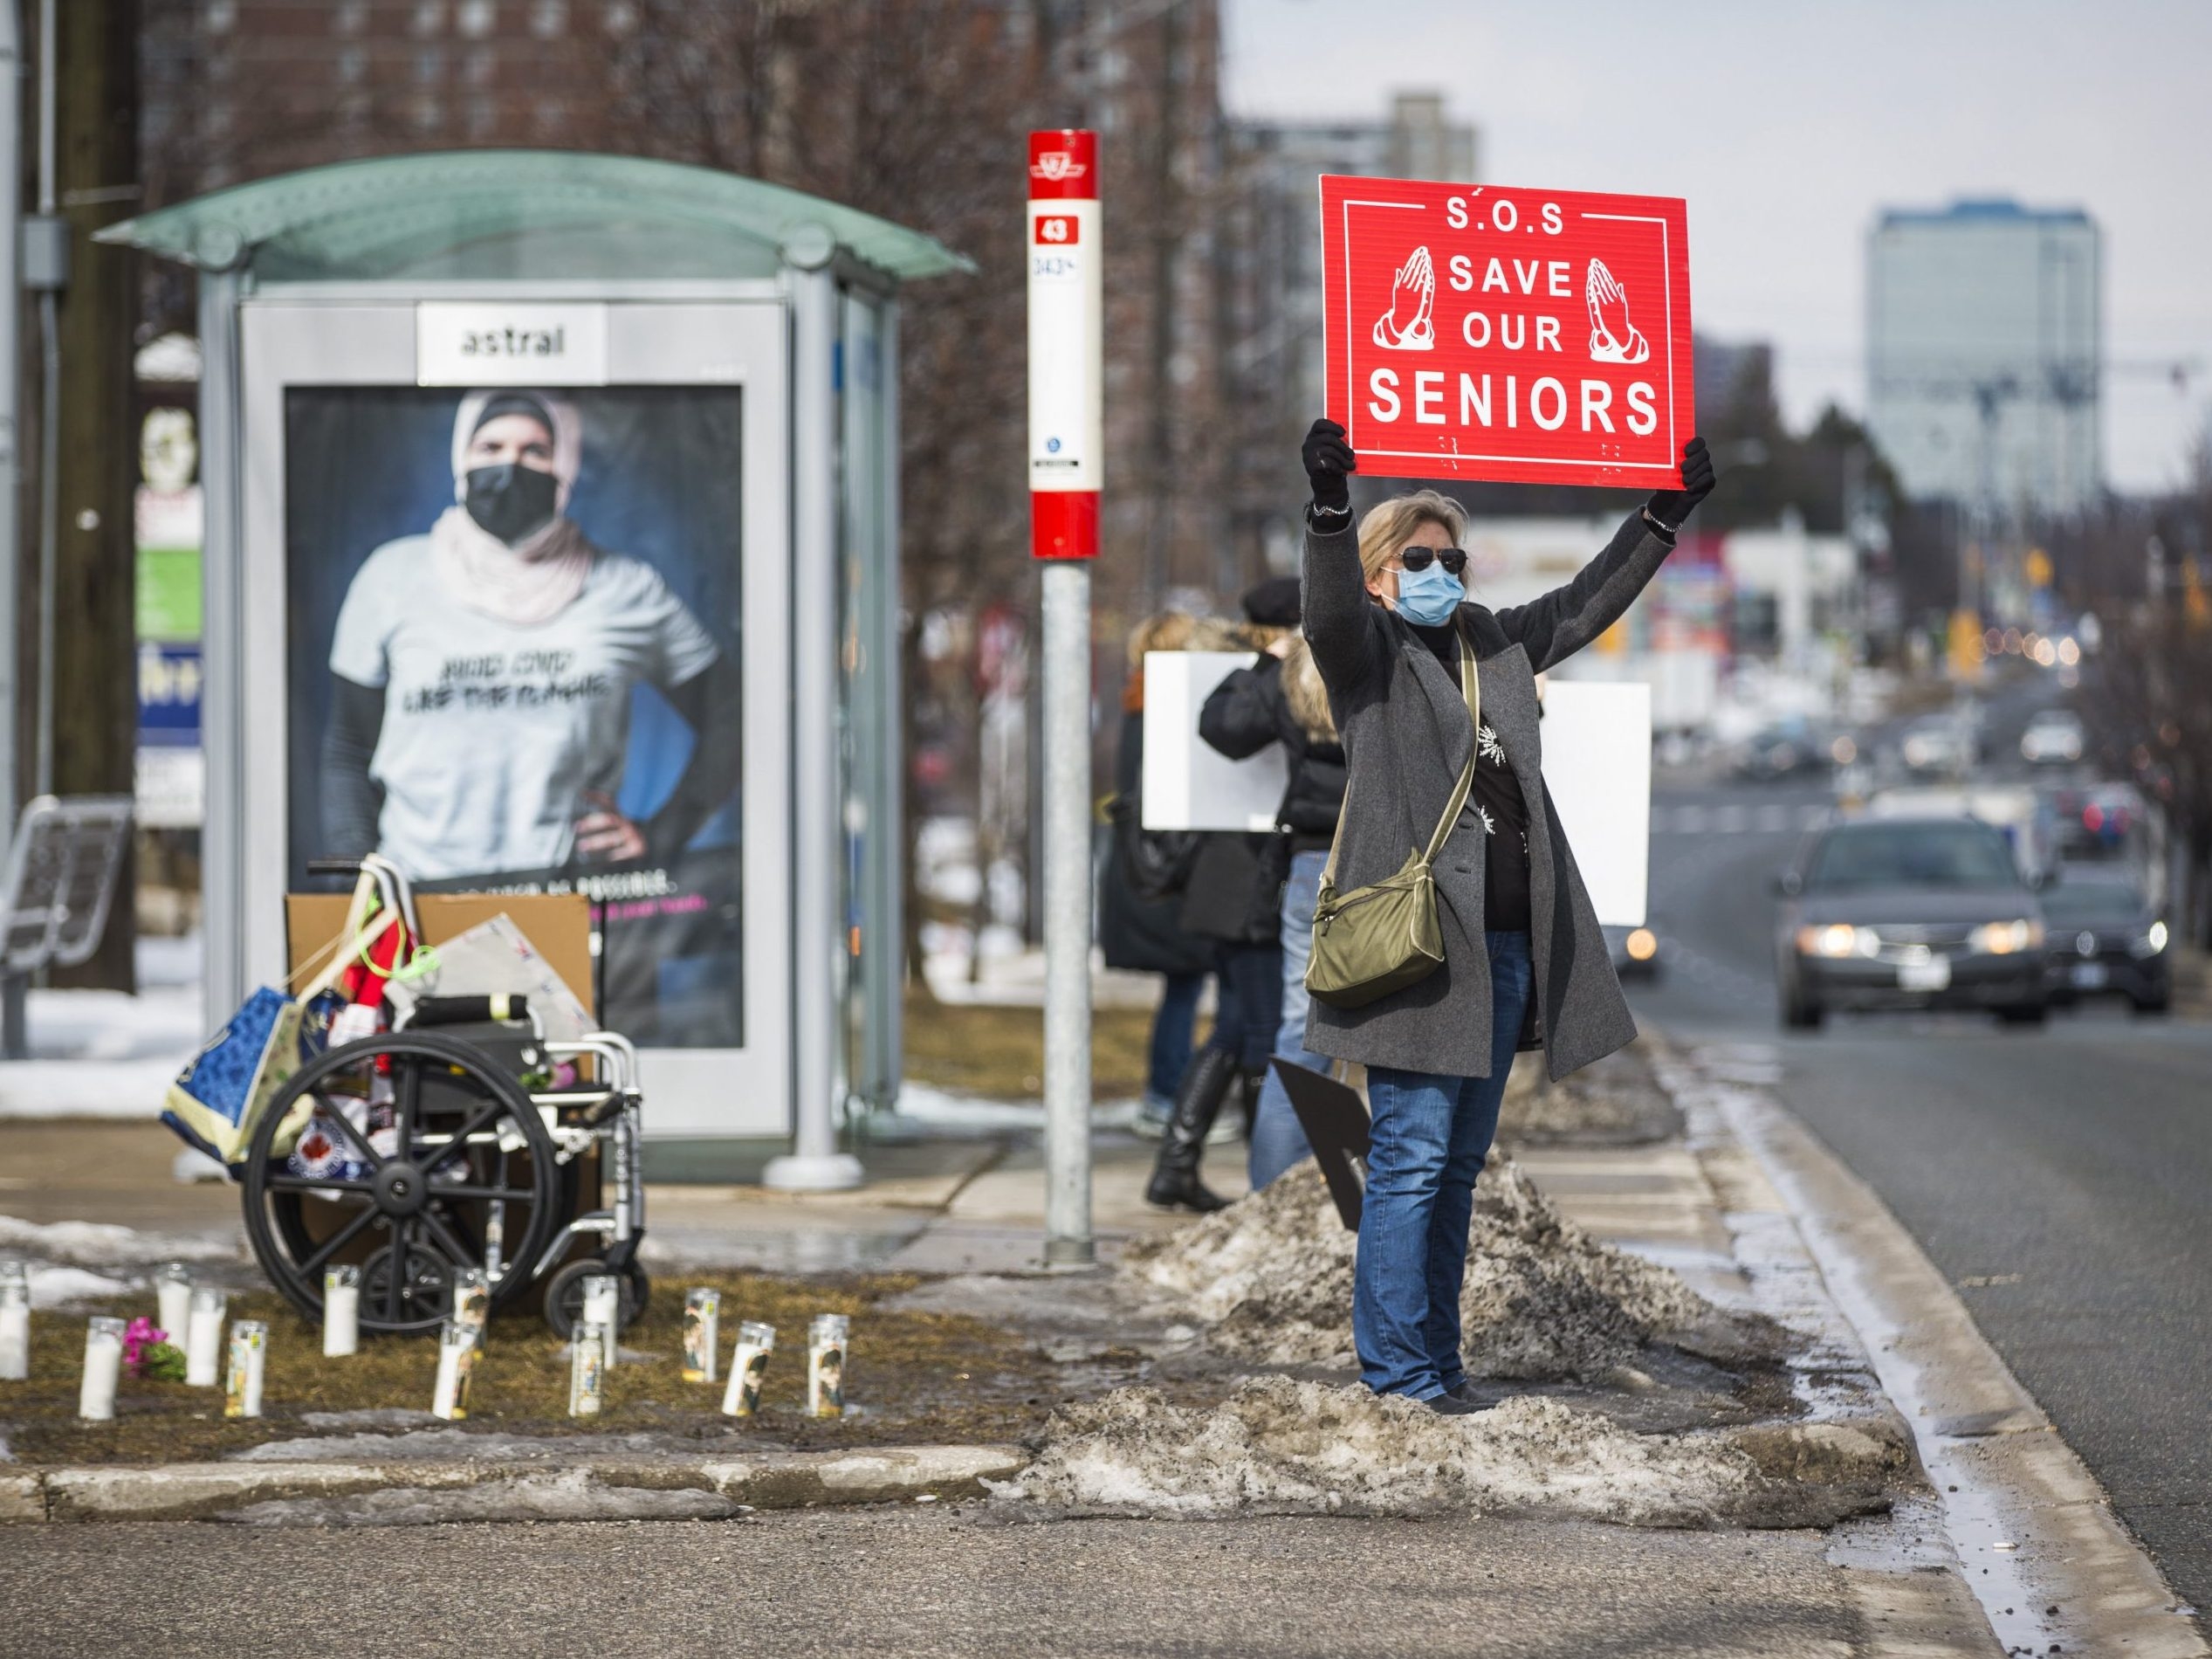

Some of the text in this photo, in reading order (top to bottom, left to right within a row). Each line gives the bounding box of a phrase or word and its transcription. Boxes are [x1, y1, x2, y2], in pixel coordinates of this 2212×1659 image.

[1446, 196, 1563, 235] S.O.S
[1449, 255, 1572, 298] SAVE
[461, 324, 565, 355] astral
[1462, 311, 1563, 353] OUR
[1368, 367, 1658, 437] SENIORS
